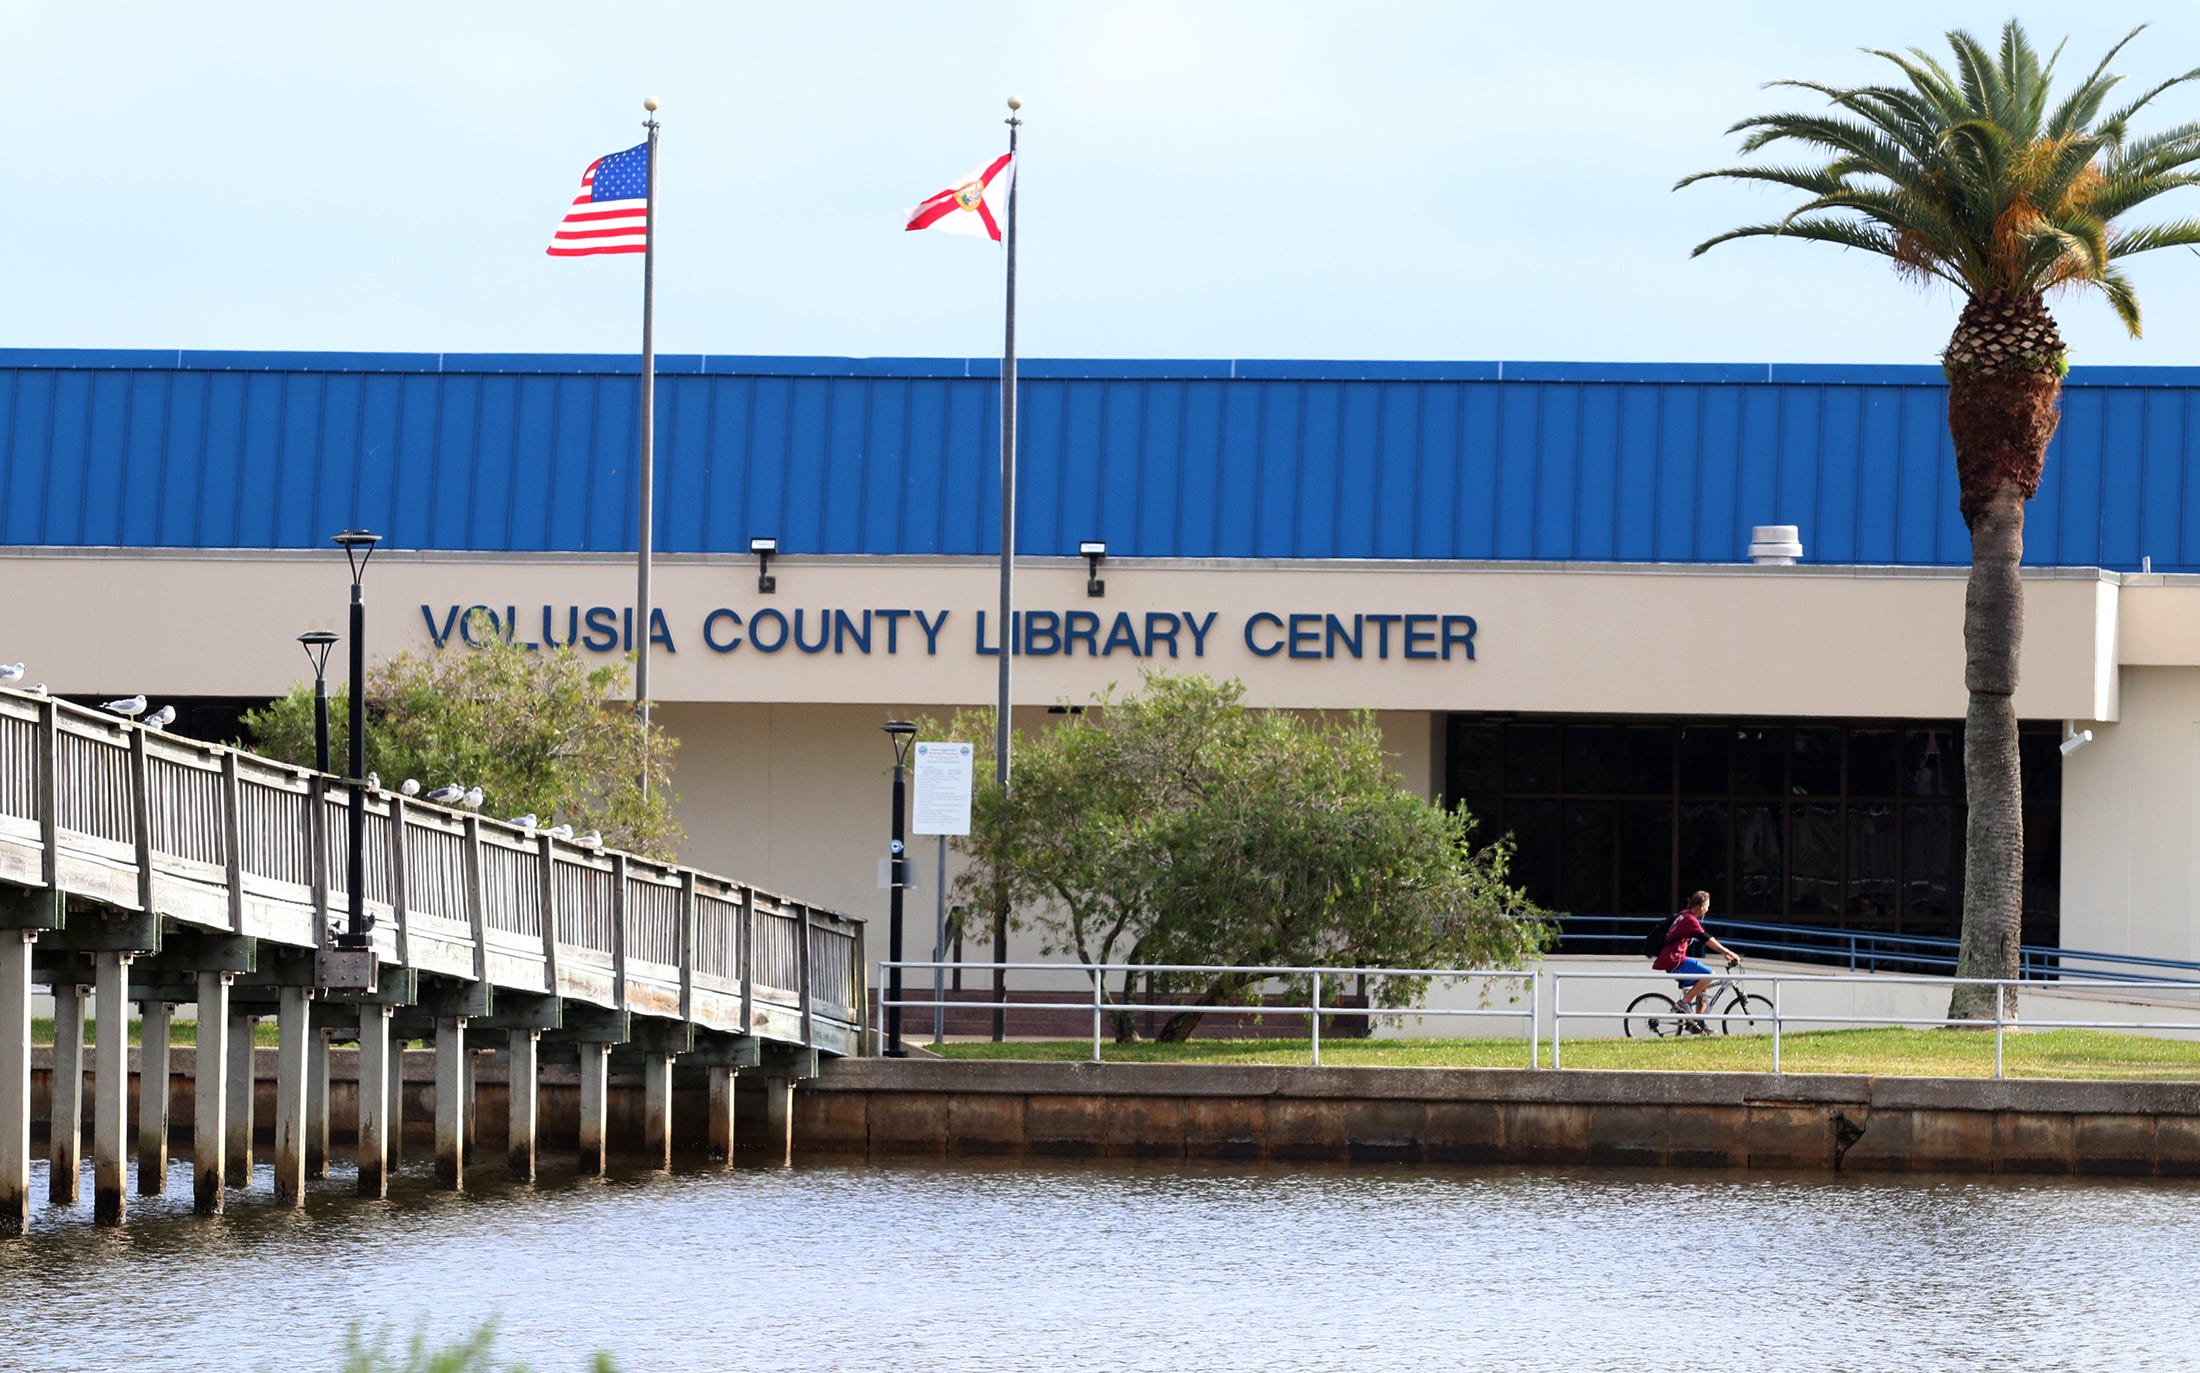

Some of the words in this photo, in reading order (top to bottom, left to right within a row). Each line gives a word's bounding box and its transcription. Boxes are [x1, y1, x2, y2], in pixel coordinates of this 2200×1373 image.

[421, 604, 677, 653] VOLUSIA
[703, 608, 950, 655] COUNTY
[975, 610, 1218, 658] LIBRARY
[1244, 612, 1478, 661] CENTER
